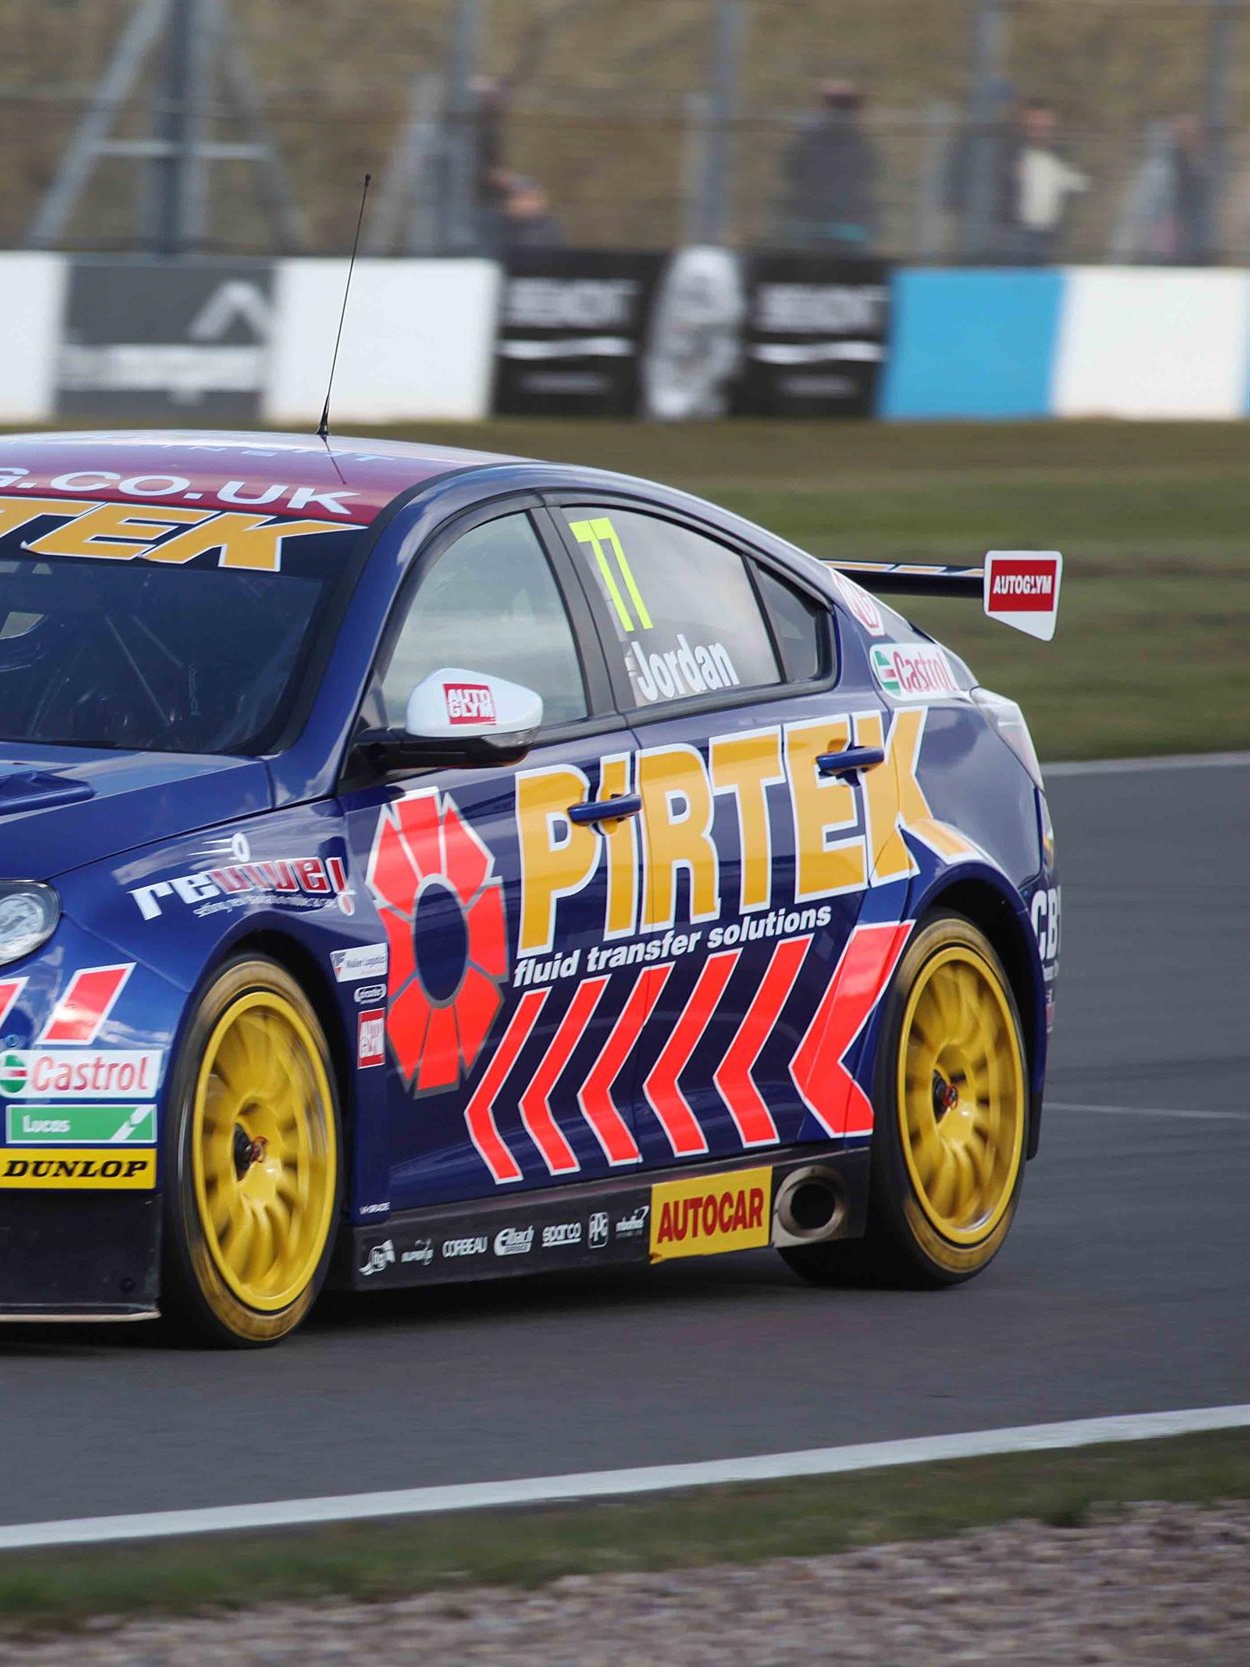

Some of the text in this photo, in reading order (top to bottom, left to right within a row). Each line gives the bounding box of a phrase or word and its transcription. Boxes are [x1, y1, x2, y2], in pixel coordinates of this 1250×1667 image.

[569, 517, 653, 632] 77
[993, 574, 1053, 595] AUTOGLYM
[631, 634, 740, 701] Jordan
[893, 650, 959, 693] Castrol
[448, 688, 491, 702] AUTO
[448, 700, 495, 718] GLYM
[515, 705, 986, 959] PIRTEK
[513, 906, 831, 988] fluid transfer solutions
[32, 1055, 149, 1092] Castrol
[22, 1114, 71, 1134] Lucas
[2, 1160, 148, 1178] DUNLOP
[657, 1187, 763, 1244] AUTOCAR
[442, 1236, 488, 1257] CORBEAU
[542, 1222, 582, 1243] sparco
